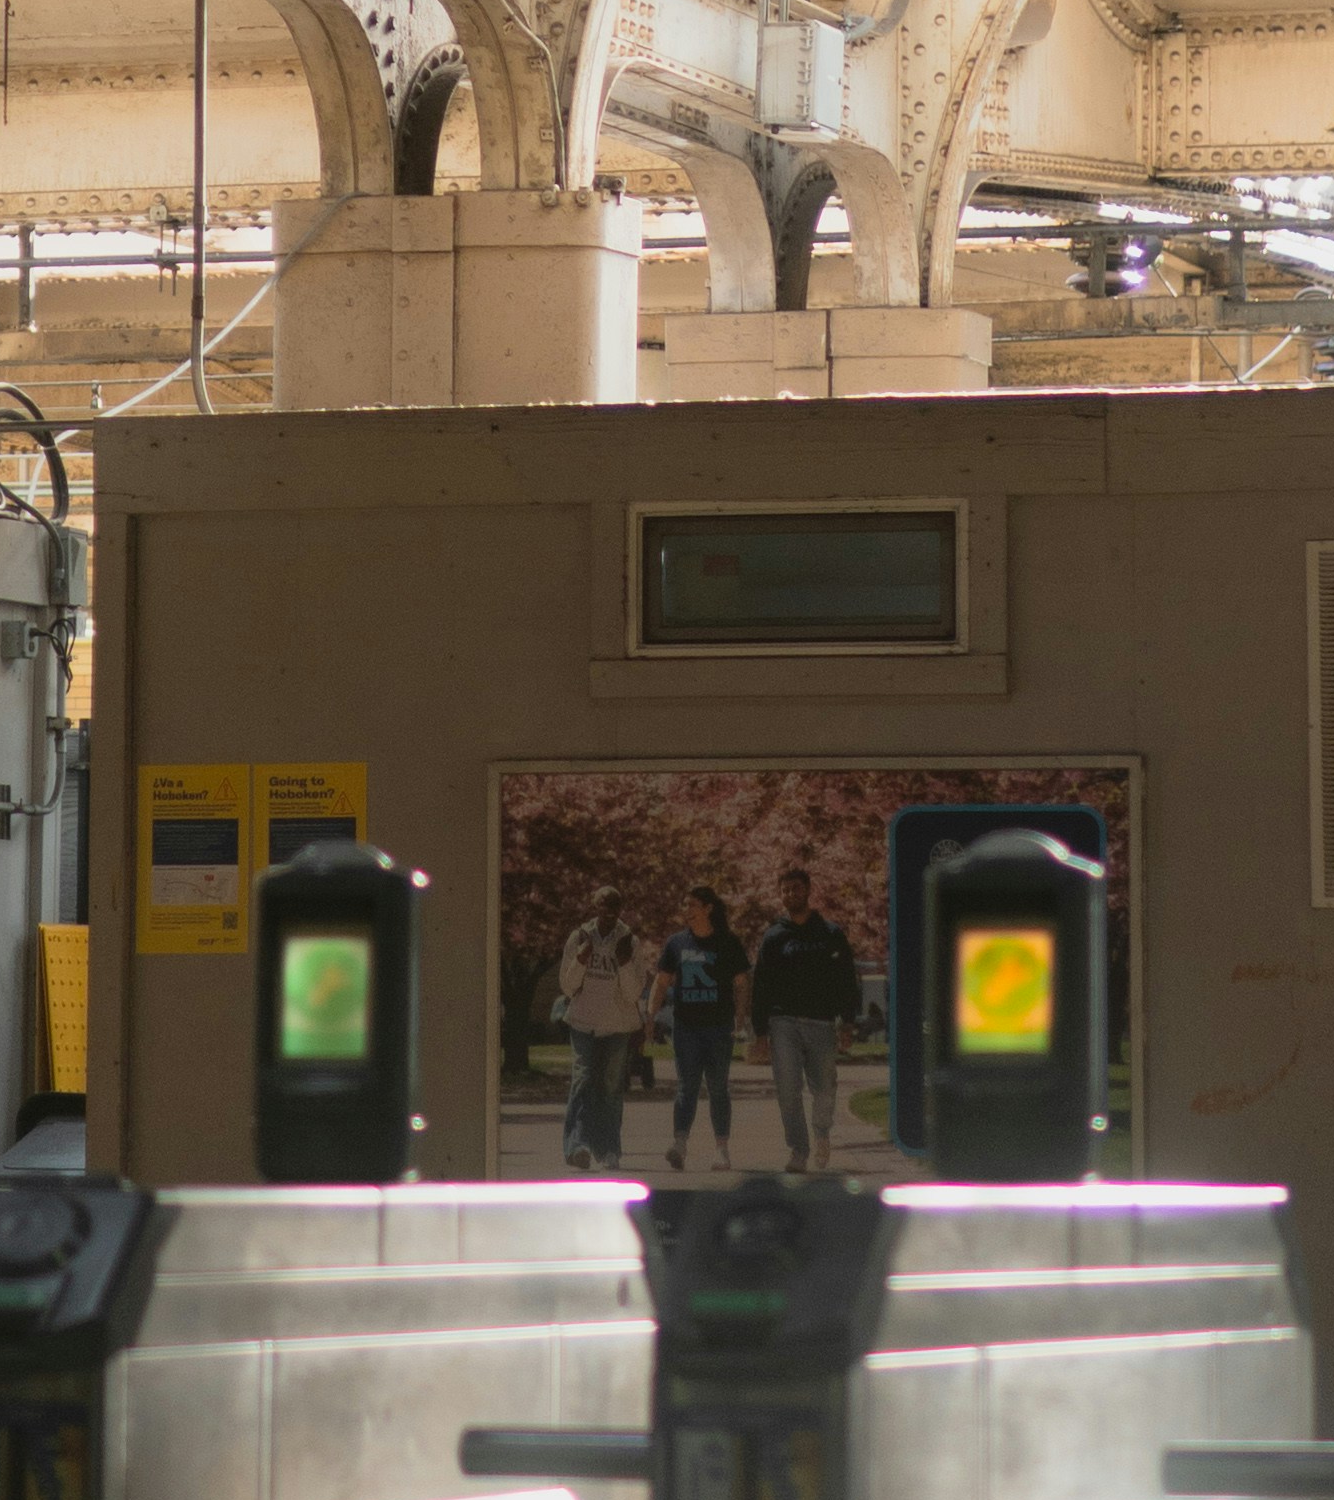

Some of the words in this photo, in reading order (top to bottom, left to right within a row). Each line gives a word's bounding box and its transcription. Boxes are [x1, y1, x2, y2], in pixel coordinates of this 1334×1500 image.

[268, 776, 307, 788] Going
[311, 776, 325, 786] to
[152, 790, 209, 802] Hoboken?
[268, 788, 335, 800] Hoboken?
[681, 988, 719, 1003] KEAN
